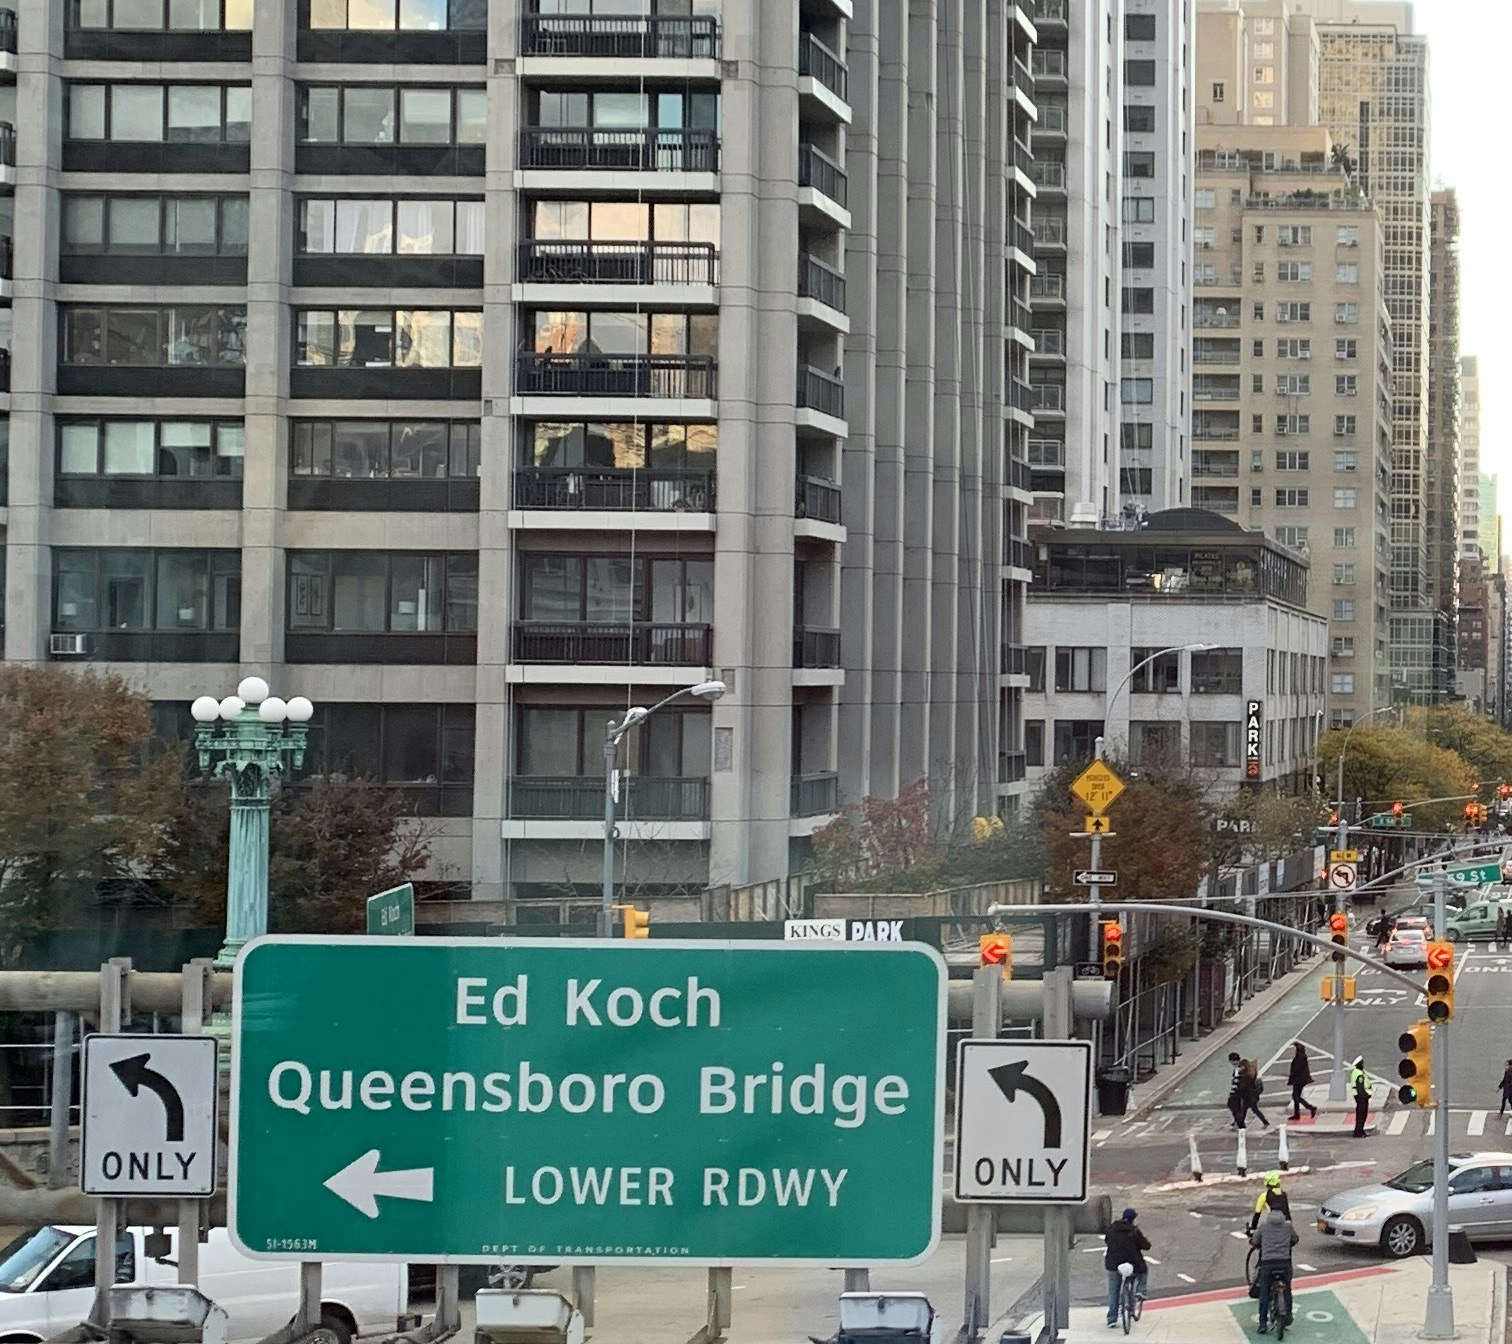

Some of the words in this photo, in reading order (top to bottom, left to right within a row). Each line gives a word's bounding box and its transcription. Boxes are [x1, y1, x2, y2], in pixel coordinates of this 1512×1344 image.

[1247, 702, 1260, 756] PARK
[1470, 869, 1486, 882] St
[790, 923, 841, 938] KINGS
[851, 920, 904, 941] PARK
[456, 974, 527, 1025] Ed
[566, 976, 721, 1027] Koch
[268, 1060, 665, 1115] Queensboro
[699, 1062, 909, 1128] Bridge
[102, 1151, 197, 1181] ONLY
[974, 1157, 1068, 1187] ONLY
[505, 1165, 675, 1206] LOWER
[703, 1168, 849, 1207] RDWY
[481, 1244, 519, 1253] DEPT
[527, 1245, 546, 1253] OF
[556, 1245, 690, 1254] TRANSPORTATION
